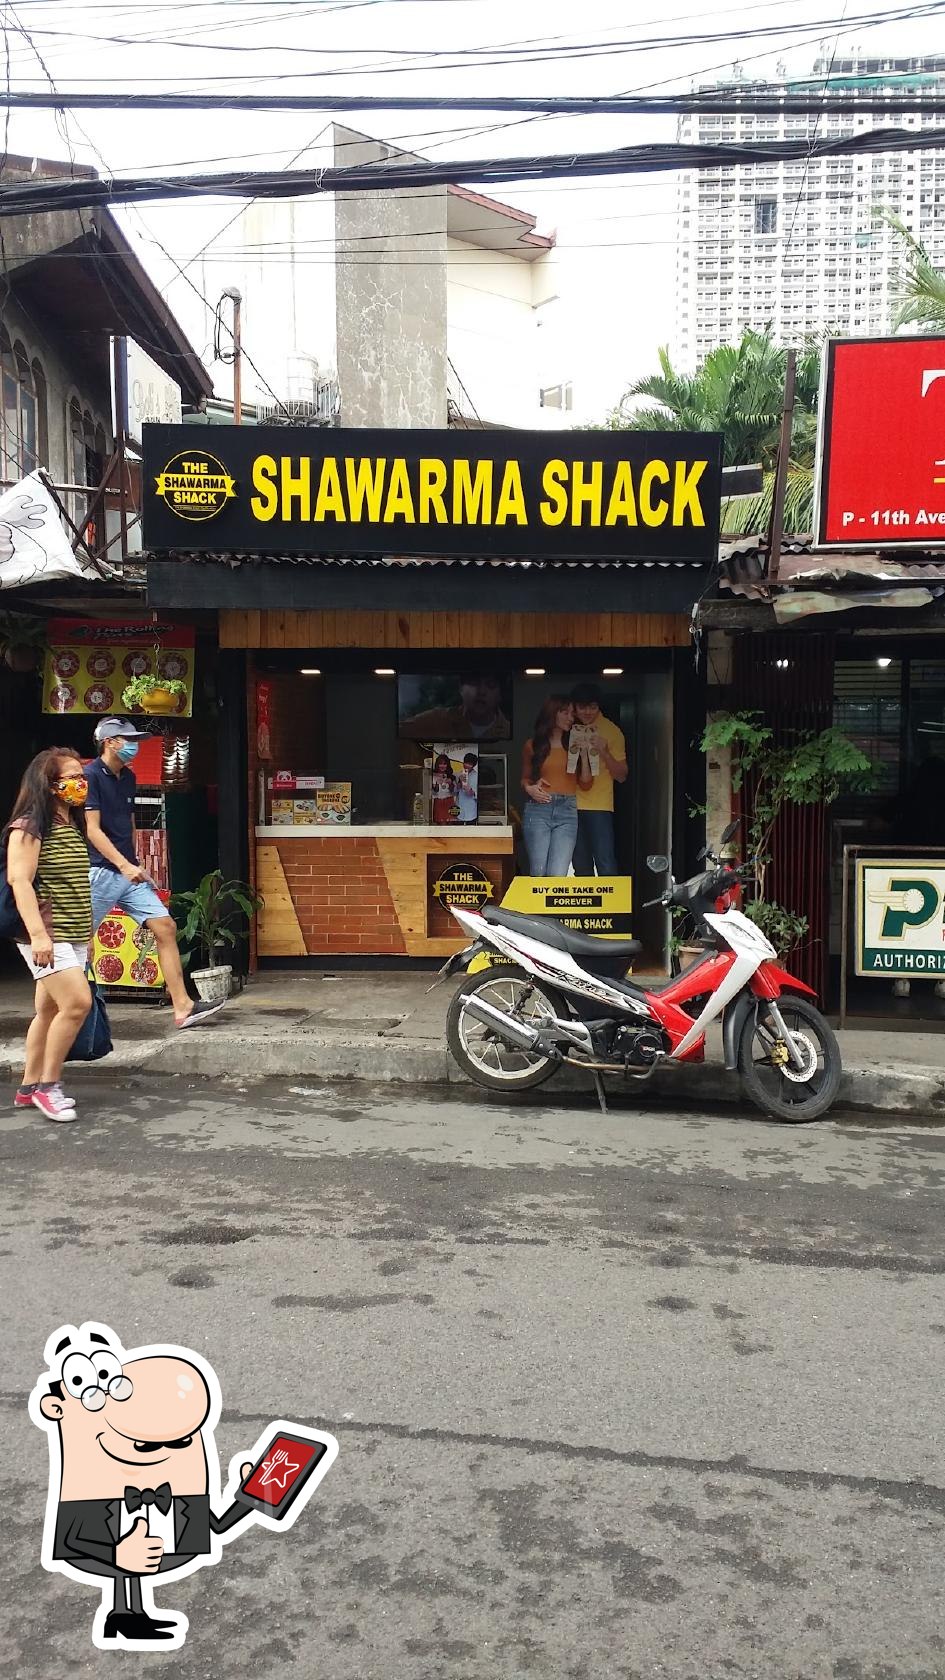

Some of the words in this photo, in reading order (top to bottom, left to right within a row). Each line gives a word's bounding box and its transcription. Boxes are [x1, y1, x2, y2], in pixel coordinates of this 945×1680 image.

[182, 462, 209, 474] THE
[164, 477, 227, 489] SHAWARMA
[251, 455, 528, 526] SHAWARMA
[540, 459, 708, 528] SHACK
[174, 492, 217, 504] SHACK
[843, 512, 855, 527] P
[871, 510, 910, 525] 11th
[453, 872, 473, 881] THE
[439, 883, 488, 893] SHAWARMA
[596, 886, 614, 894] ONE
[446, 894, 480, 904] SHACK
[553, 898, 593, 906] FOREVER
[583, 919, 613, 929] SHACK
